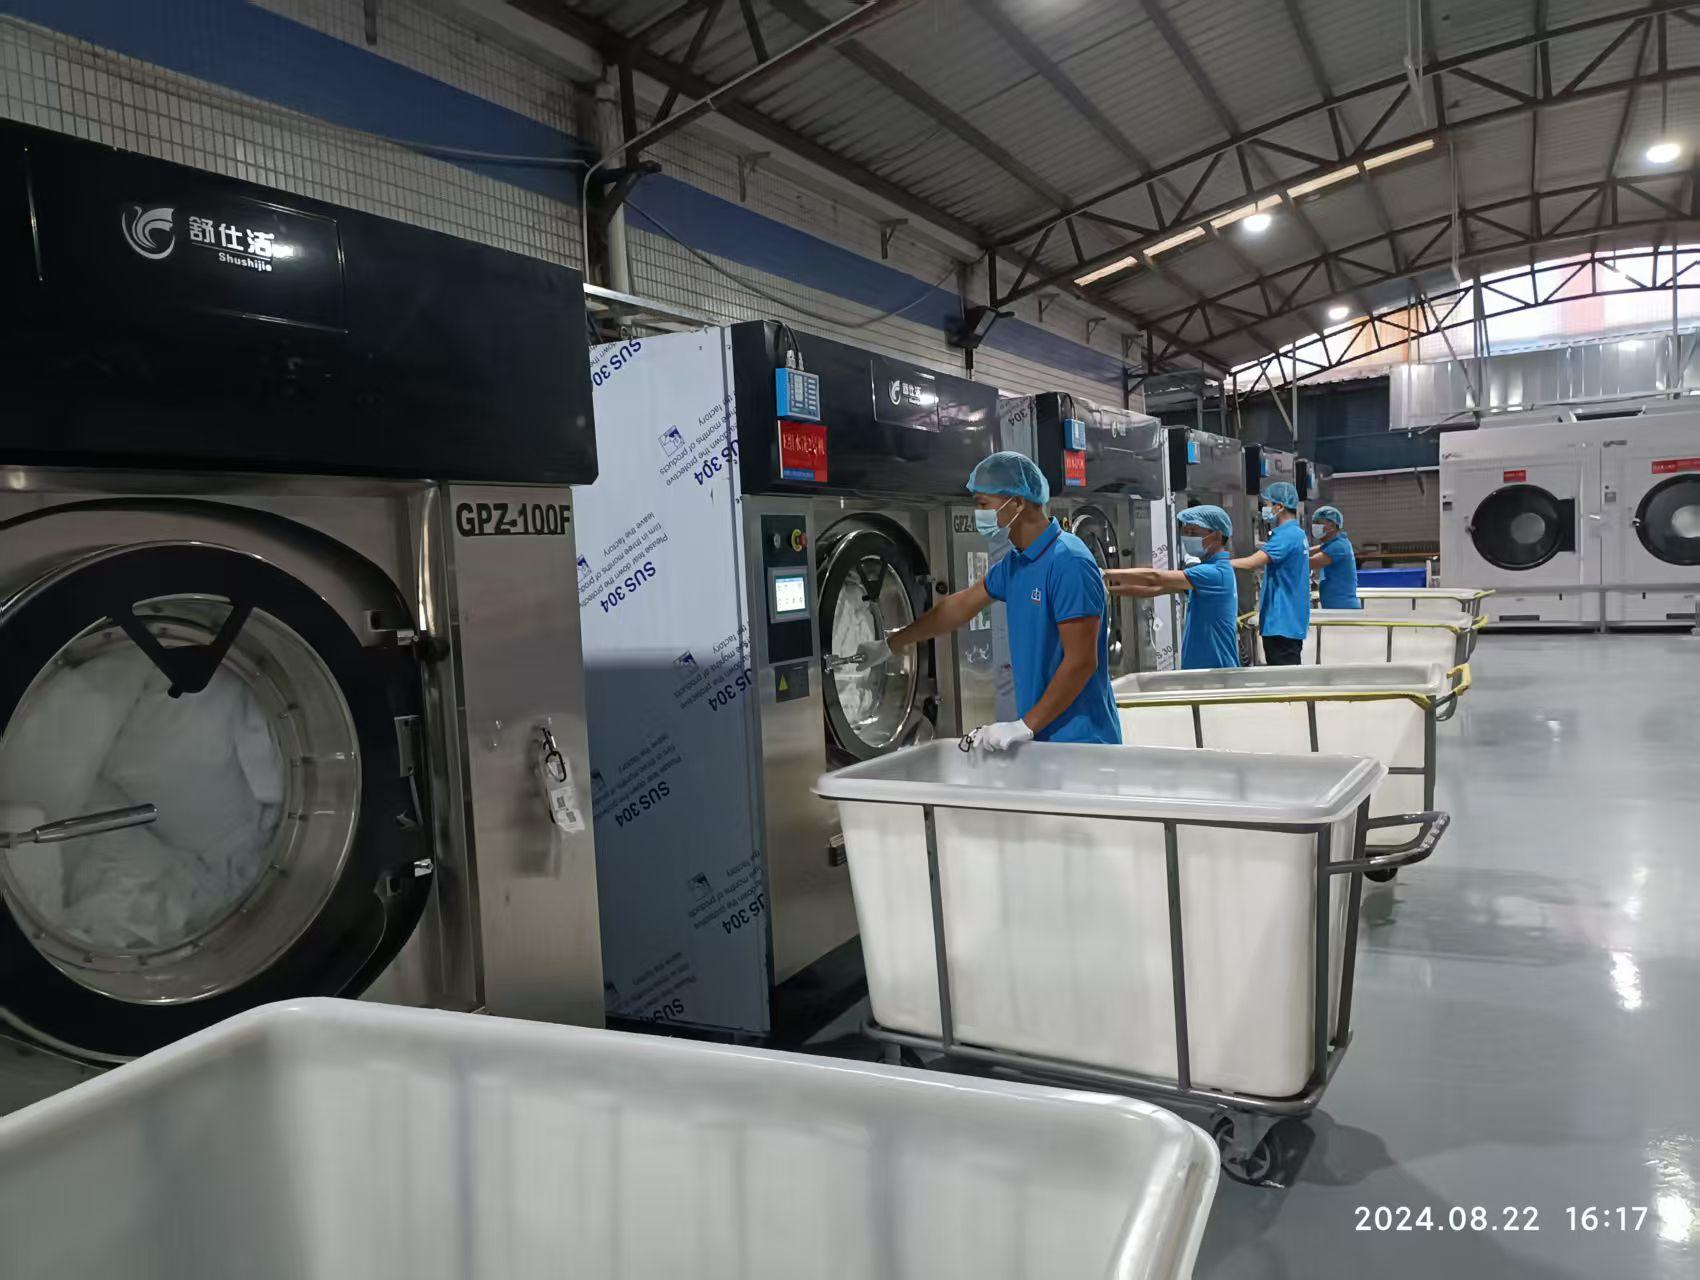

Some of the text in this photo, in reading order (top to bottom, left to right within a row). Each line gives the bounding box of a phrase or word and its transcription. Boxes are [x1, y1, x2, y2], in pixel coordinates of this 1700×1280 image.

[610, 340, 641, 370] SUS
[695, 420, 722, 446] months
[659, 447, 688, 475] products
[689, 442, 696, 454] of
[698, 447, 711, 459] the
[665, 456, 698, 486] protective
[694, 457, 722, 486] 304
[456, 502, 570, 537] GPZ-100F
[647, 522, 662, 536] film
[603, 512, 655, 557] leave the factory
[624, 538, 642, 555] three
[641, 532, 650, 542] in
[644, 532, 669, 554] Please
[595, 571, 602, 581] of
[601, 553, 625, 574] months
[613, 562, 632, 580] down
[600, 561, 656, 613] SUS 304
[604, 577, 616, 589] the
[708, 684, 736, 712] 304
[639, 781, 670, 810] SUS
[615, 802, 640, 828] 304
[722, 909, 750, 935] 304
